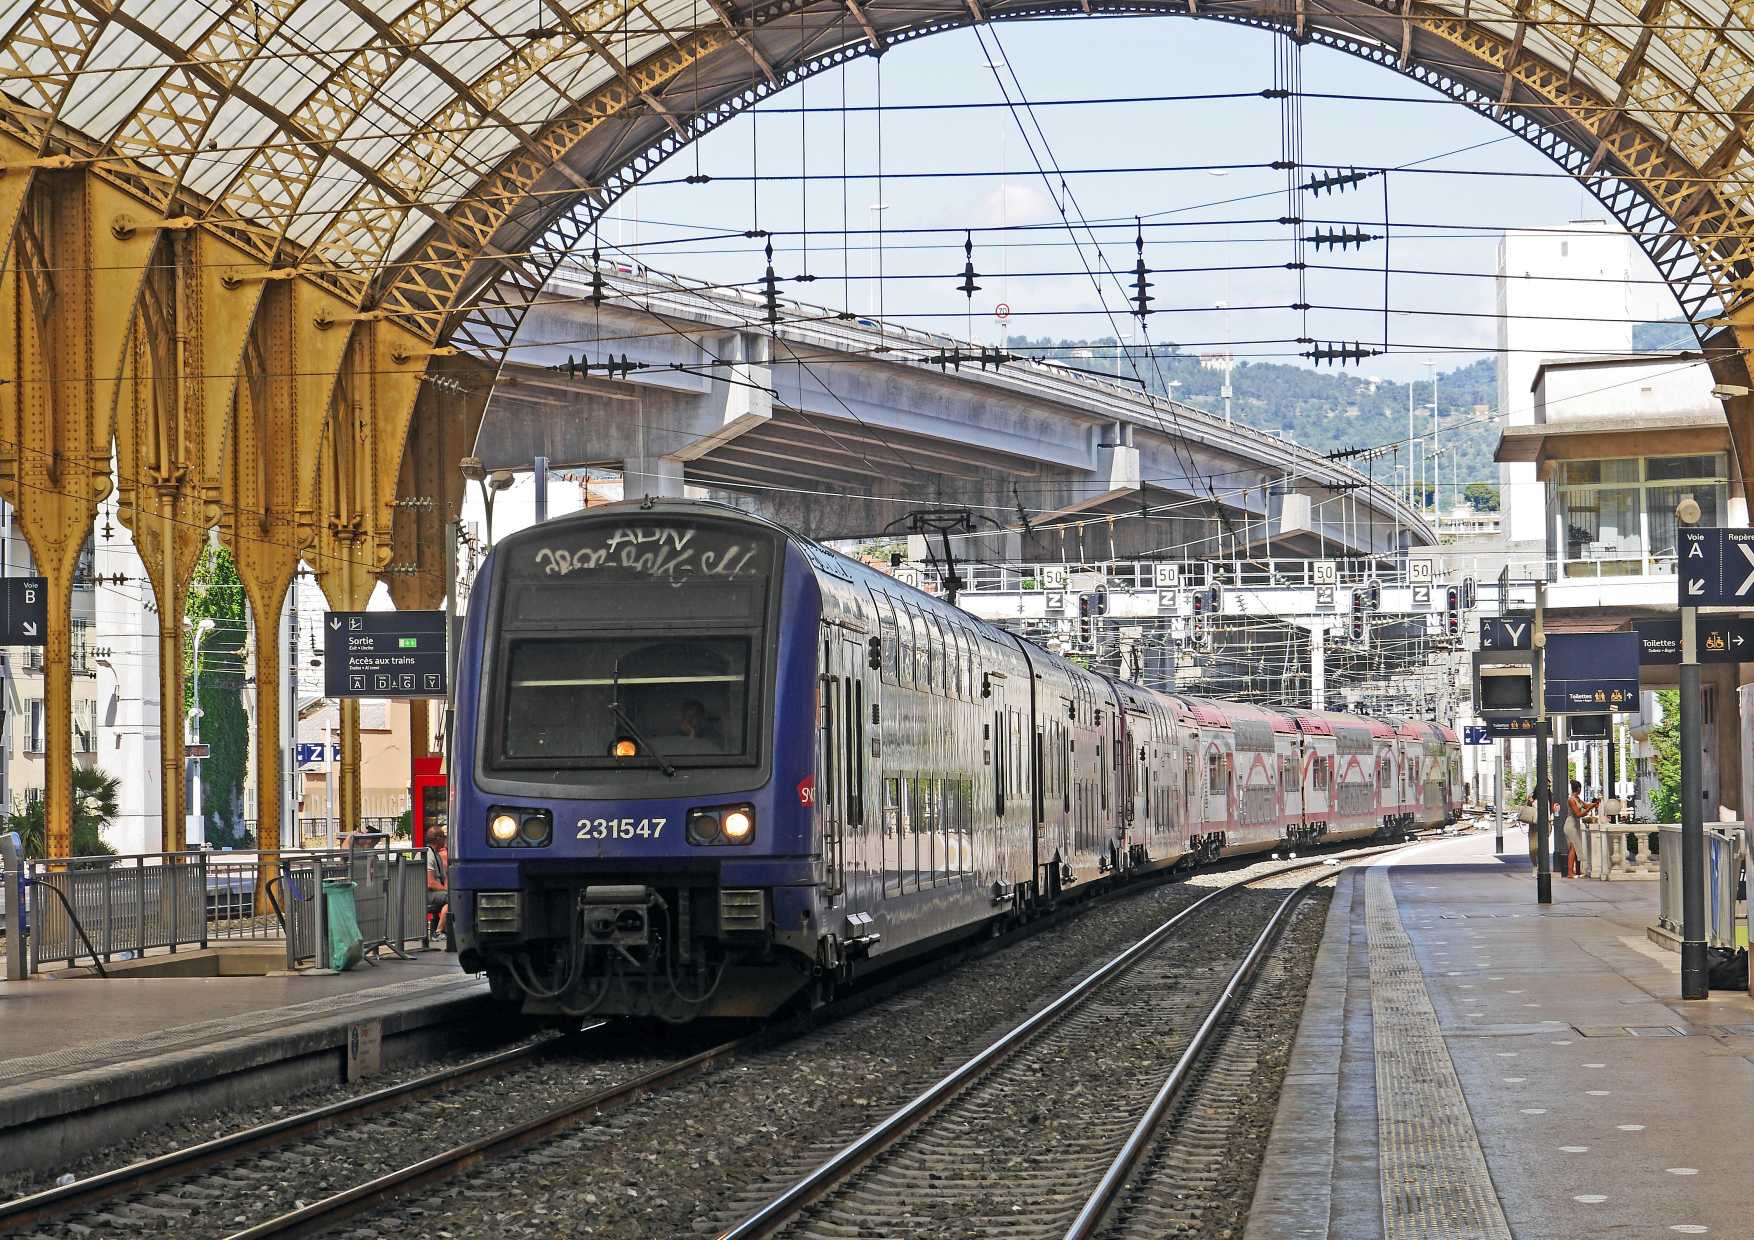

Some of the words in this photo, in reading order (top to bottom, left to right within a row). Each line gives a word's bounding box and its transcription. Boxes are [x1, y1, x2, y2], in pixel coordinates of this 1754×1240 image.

[1687, 533, 1705, 541] Voie
[1688, 542, 1703, 558] A
[1159, 568, 1175, 581] 50
[1317, 566, 1333, 579] 50
[1413, 564, 1429, 577] 50
[1046, 571, 1062, 584] 50
[25, 589, 36, 604] B
[1483, 623, 1491, 631] A
[348, 637, 374, 645] Sortie
[1504, 624, 1526, 647] Y
[1642, 639, 1676, 647] Toilettes
[349, 656, 373, 665] Accès
[391, 656, 415, 665] trains
[354, 681, 361, 689] A
[379, 680, 387, 688] D
[403, 680, 411, 688] G
[429, 680, 436, 688] Y
[310, 746, 322, 760] Z
[576, 818, 667, 839] 231547
